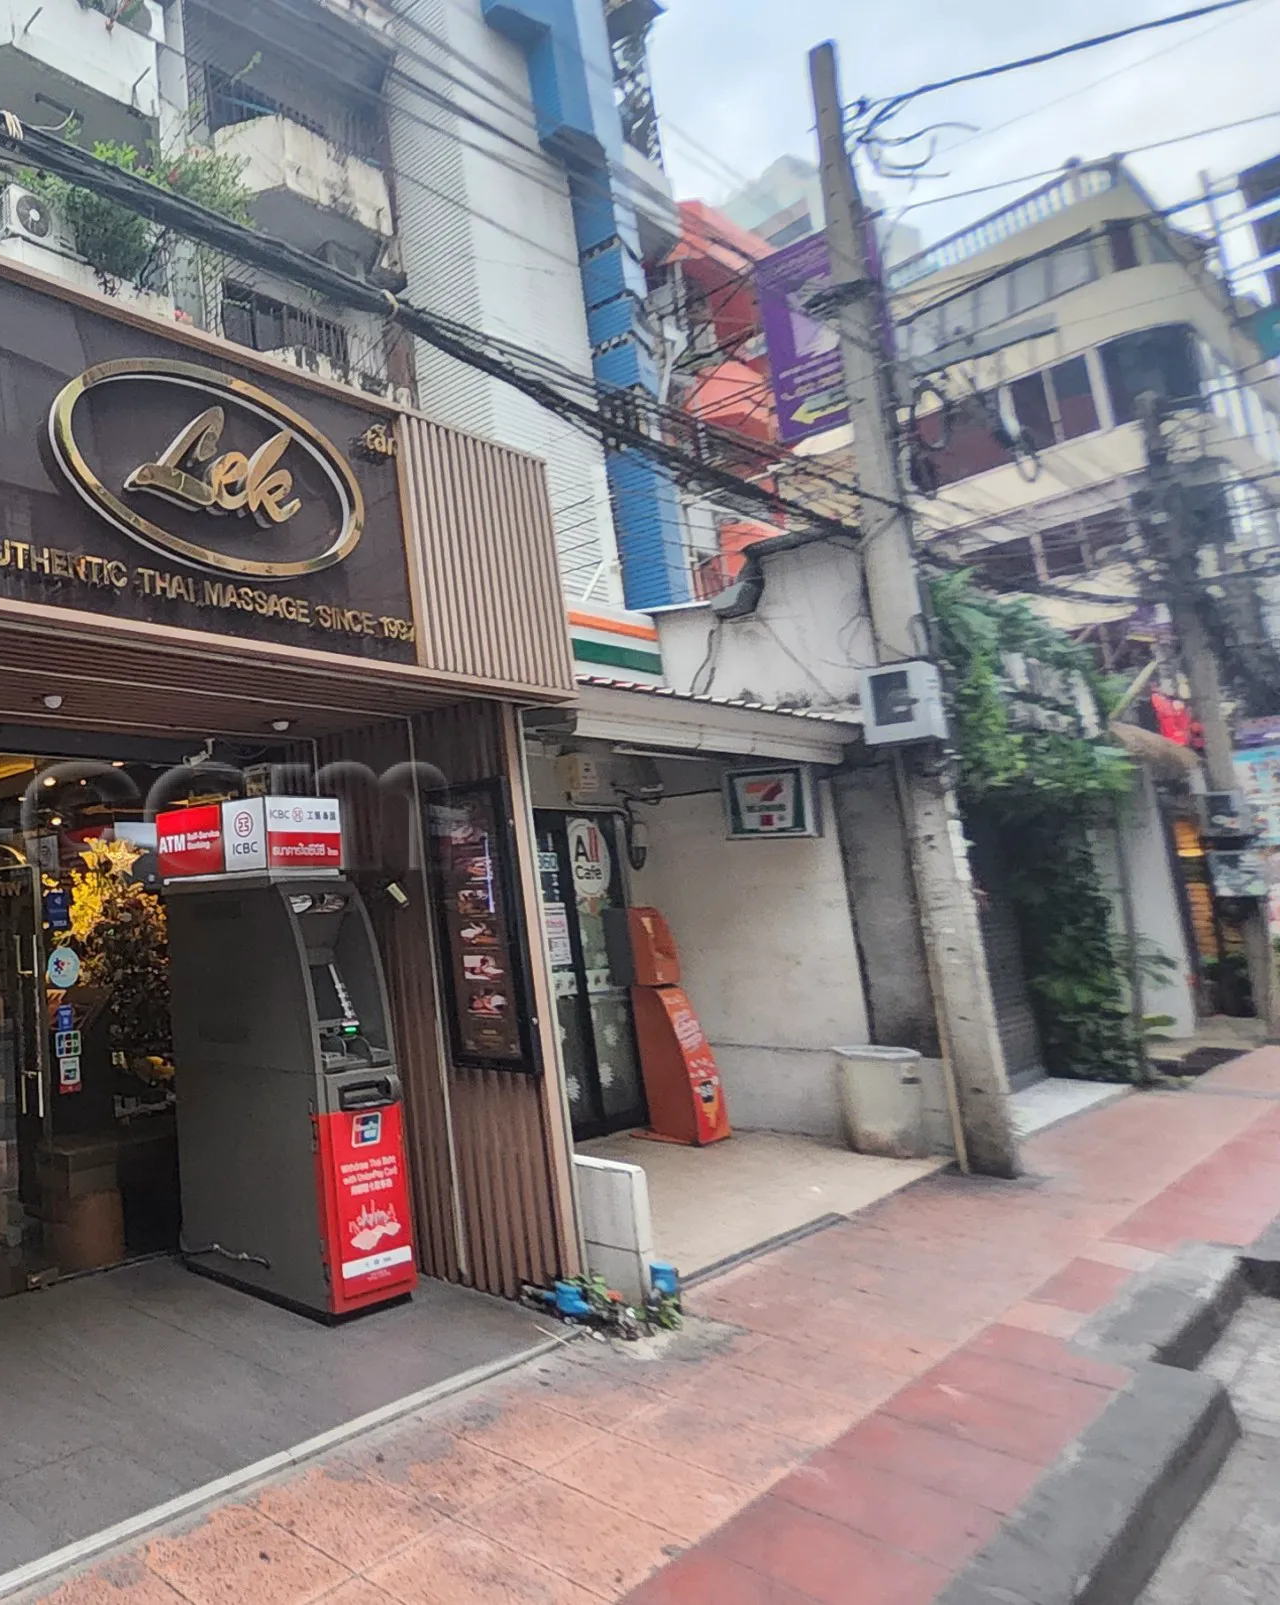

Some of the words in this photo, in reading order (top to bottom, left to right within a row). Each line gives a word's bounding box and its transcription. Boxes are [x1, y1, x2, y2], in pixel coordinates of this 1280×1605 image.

[124, 406, 301, 523] Lek
[138, 567, 196, 603] THAI
[203, 580, 311, 623] MASSAGE
[315, 605, 378, 635] SINCE
[159, 833, 186, 854] ATM
[233, 841, 259, 856] ICBC
[574, 826, 600, 863] All
[575, 865, 602, 880] Cafe
